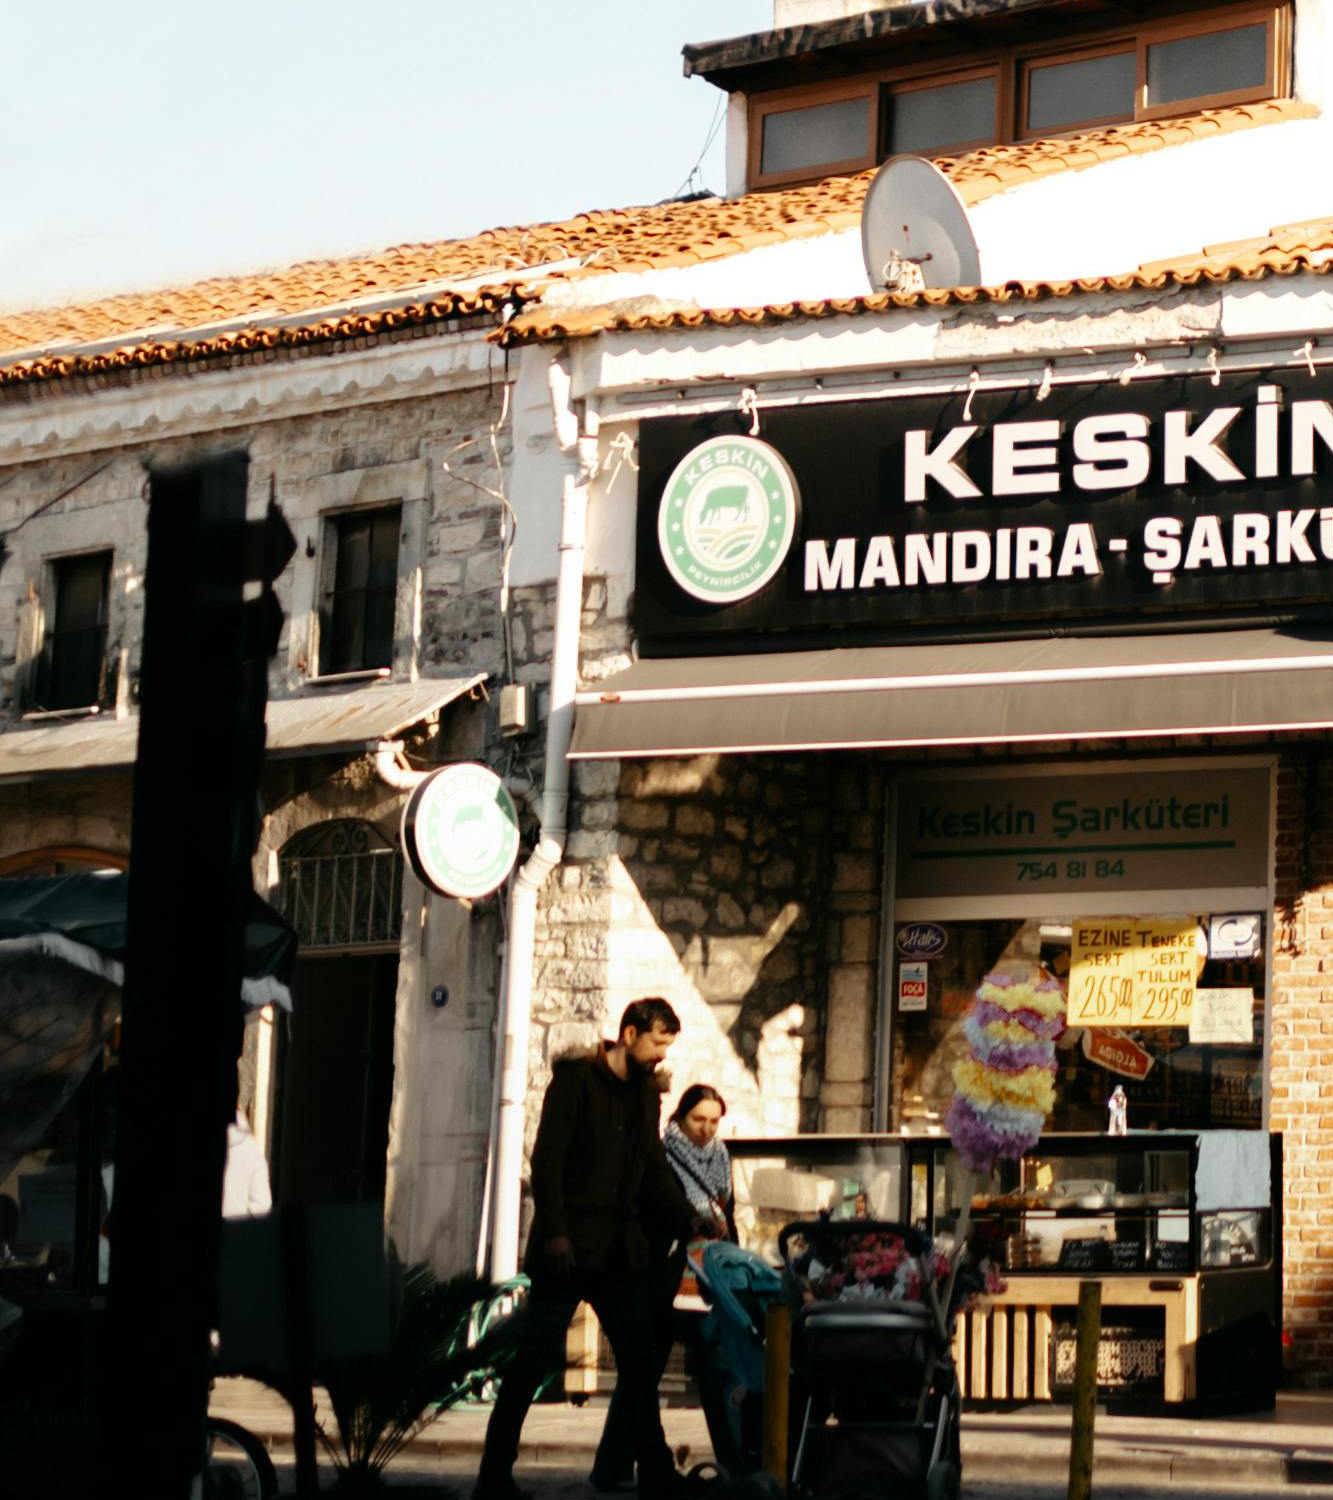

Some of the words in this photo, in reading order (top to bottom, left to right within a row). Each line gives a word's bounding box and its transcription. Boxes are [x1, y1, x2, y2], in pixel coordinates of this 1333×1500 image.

[684, 448, 769, 486] KESKİN
[803, 523, 1100, 591] MANDIRA
[918, 801, 1036, 838] Keskin
[1051, 794, 1230, 839] Şarküteri
[1016, 861, 1058, 881] 754
[1066, 861, 1086, 879] 81
[1094, 859, 1125, 878] 84
[1084, 952, 1124, 967] SERT
[1150, 952, 1187, 966] SERT
[1137, 969, 1191, 982] TULUM
